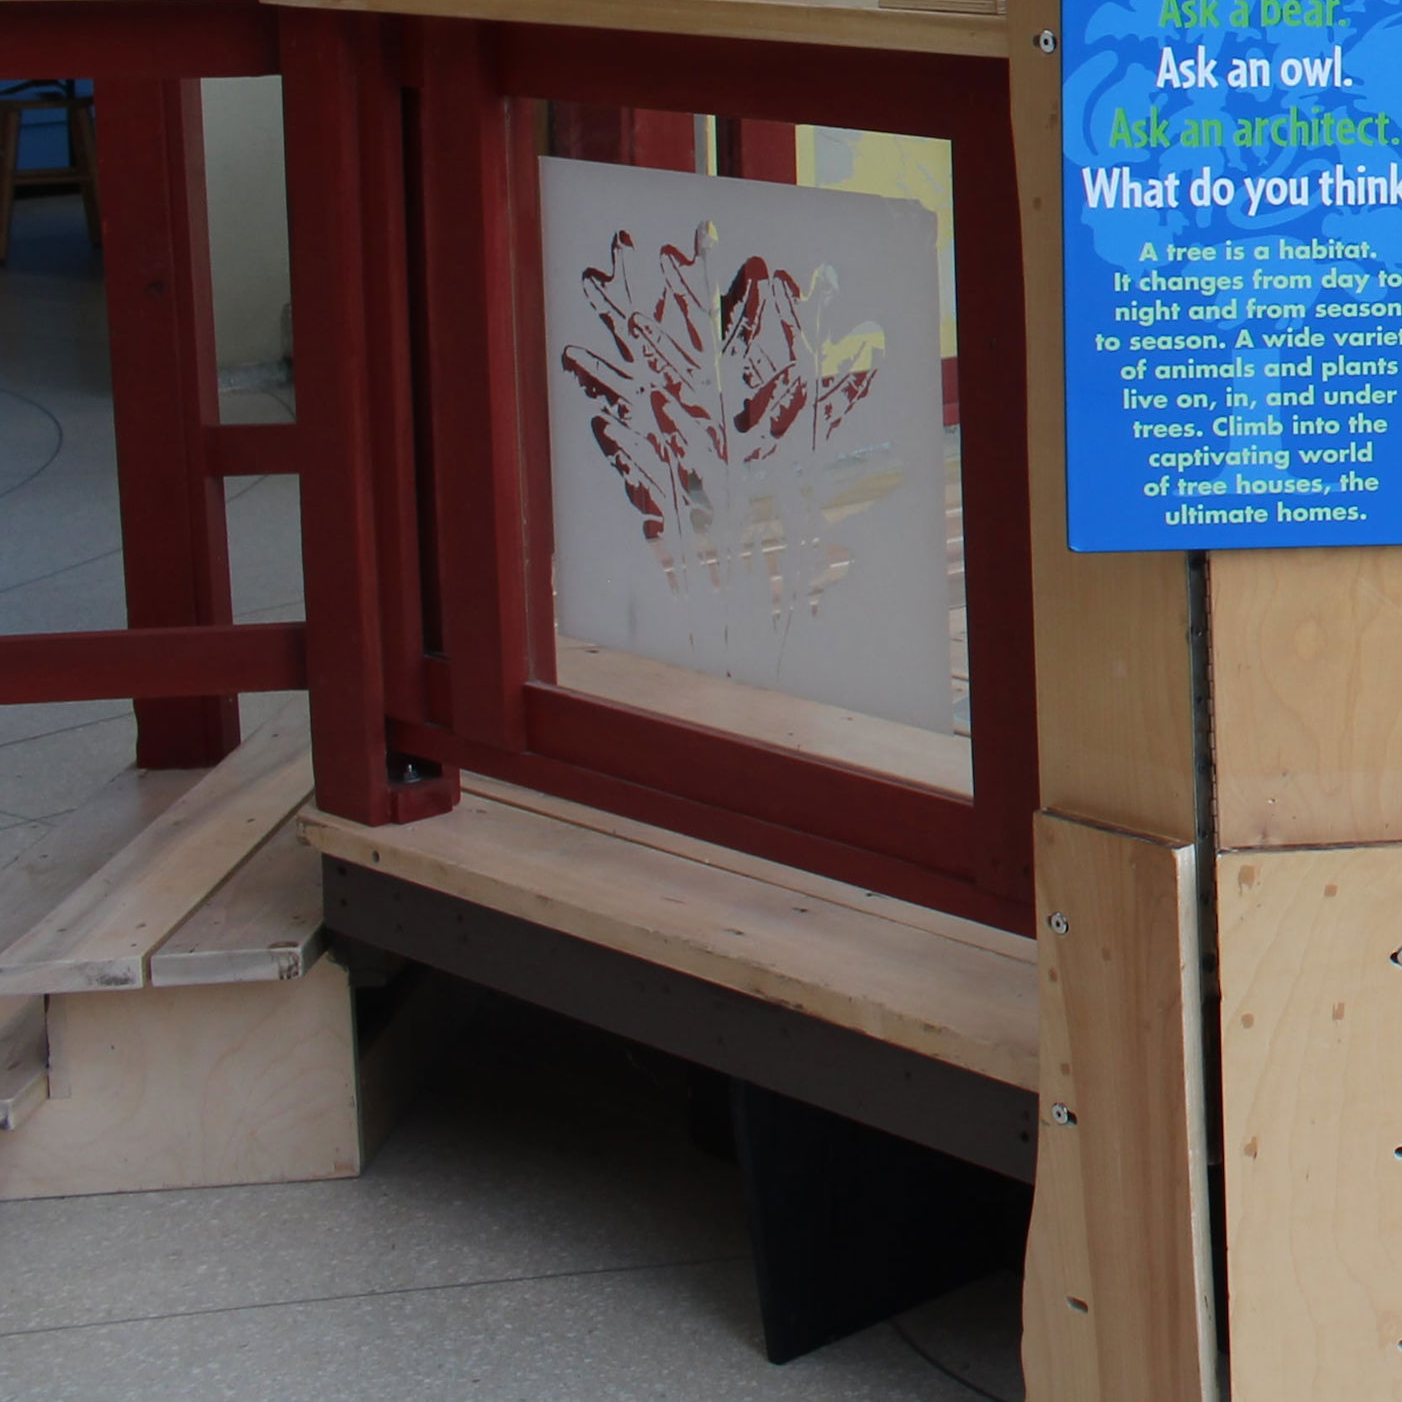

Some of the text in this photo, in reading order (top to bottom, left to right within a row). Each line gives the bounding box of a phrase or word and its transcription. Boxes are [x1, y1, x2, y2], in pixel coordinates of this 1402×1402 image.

[1156, 45, 1353, 88] Ask an owl.
[1109, 106, 1400, 148] Ask an architect.
[1082, 166, 1179, 209] What
[1190, 166, 1233, 207] do
[1243, 175, 1309, 216] you
[1139, 238, 1377, 262] A tree is a habitat.
[1114, 268, 1402, 296] It changes from day to
[1115, 299, 1402, 326] night and from season
[1095, 332, 1120, 351] to
[1129, 332, 1226, 350] season.
[1234, 330, 1254, 349] A
[1262, 328, 1326, 347] wide
[1120, 356, 1399, 381] of animals and plants
[1123, 384, 1397, 411] live on, in, and under
[1133, 413, 1388, 438] trees. Climb into the
[1148, 442, 1373, 472] captivating world
[1143, 472, 1379, 496] of tree houses, the
[1165, 502, 1367, 525] ultimate homes.
